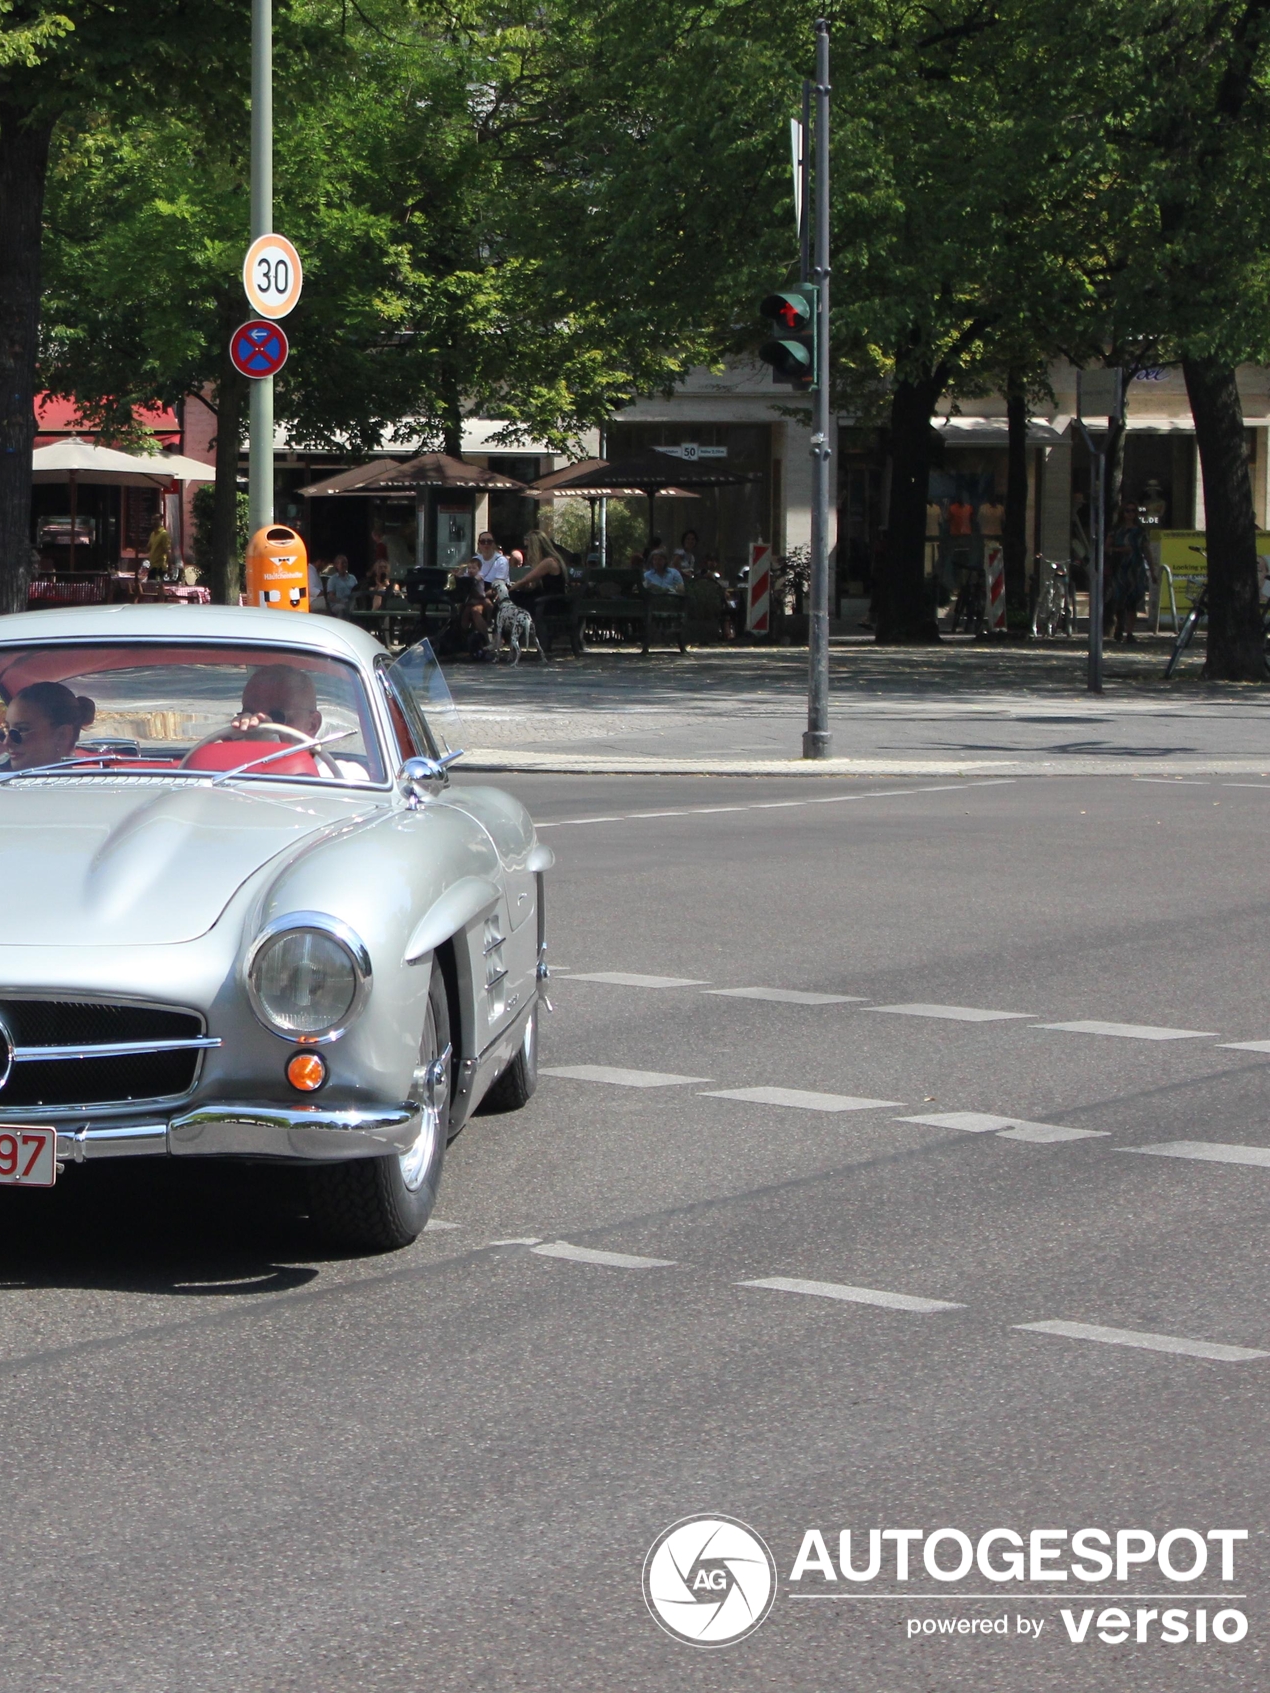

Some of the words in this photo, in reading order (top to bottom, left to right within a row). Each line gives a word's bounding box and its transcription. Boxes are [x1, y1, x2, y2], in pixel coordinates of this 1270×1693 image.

[257, 257, 288, 294] 30
[684, 447, 696, 457] 50
[1172, 564, 1199, 572] Looking
